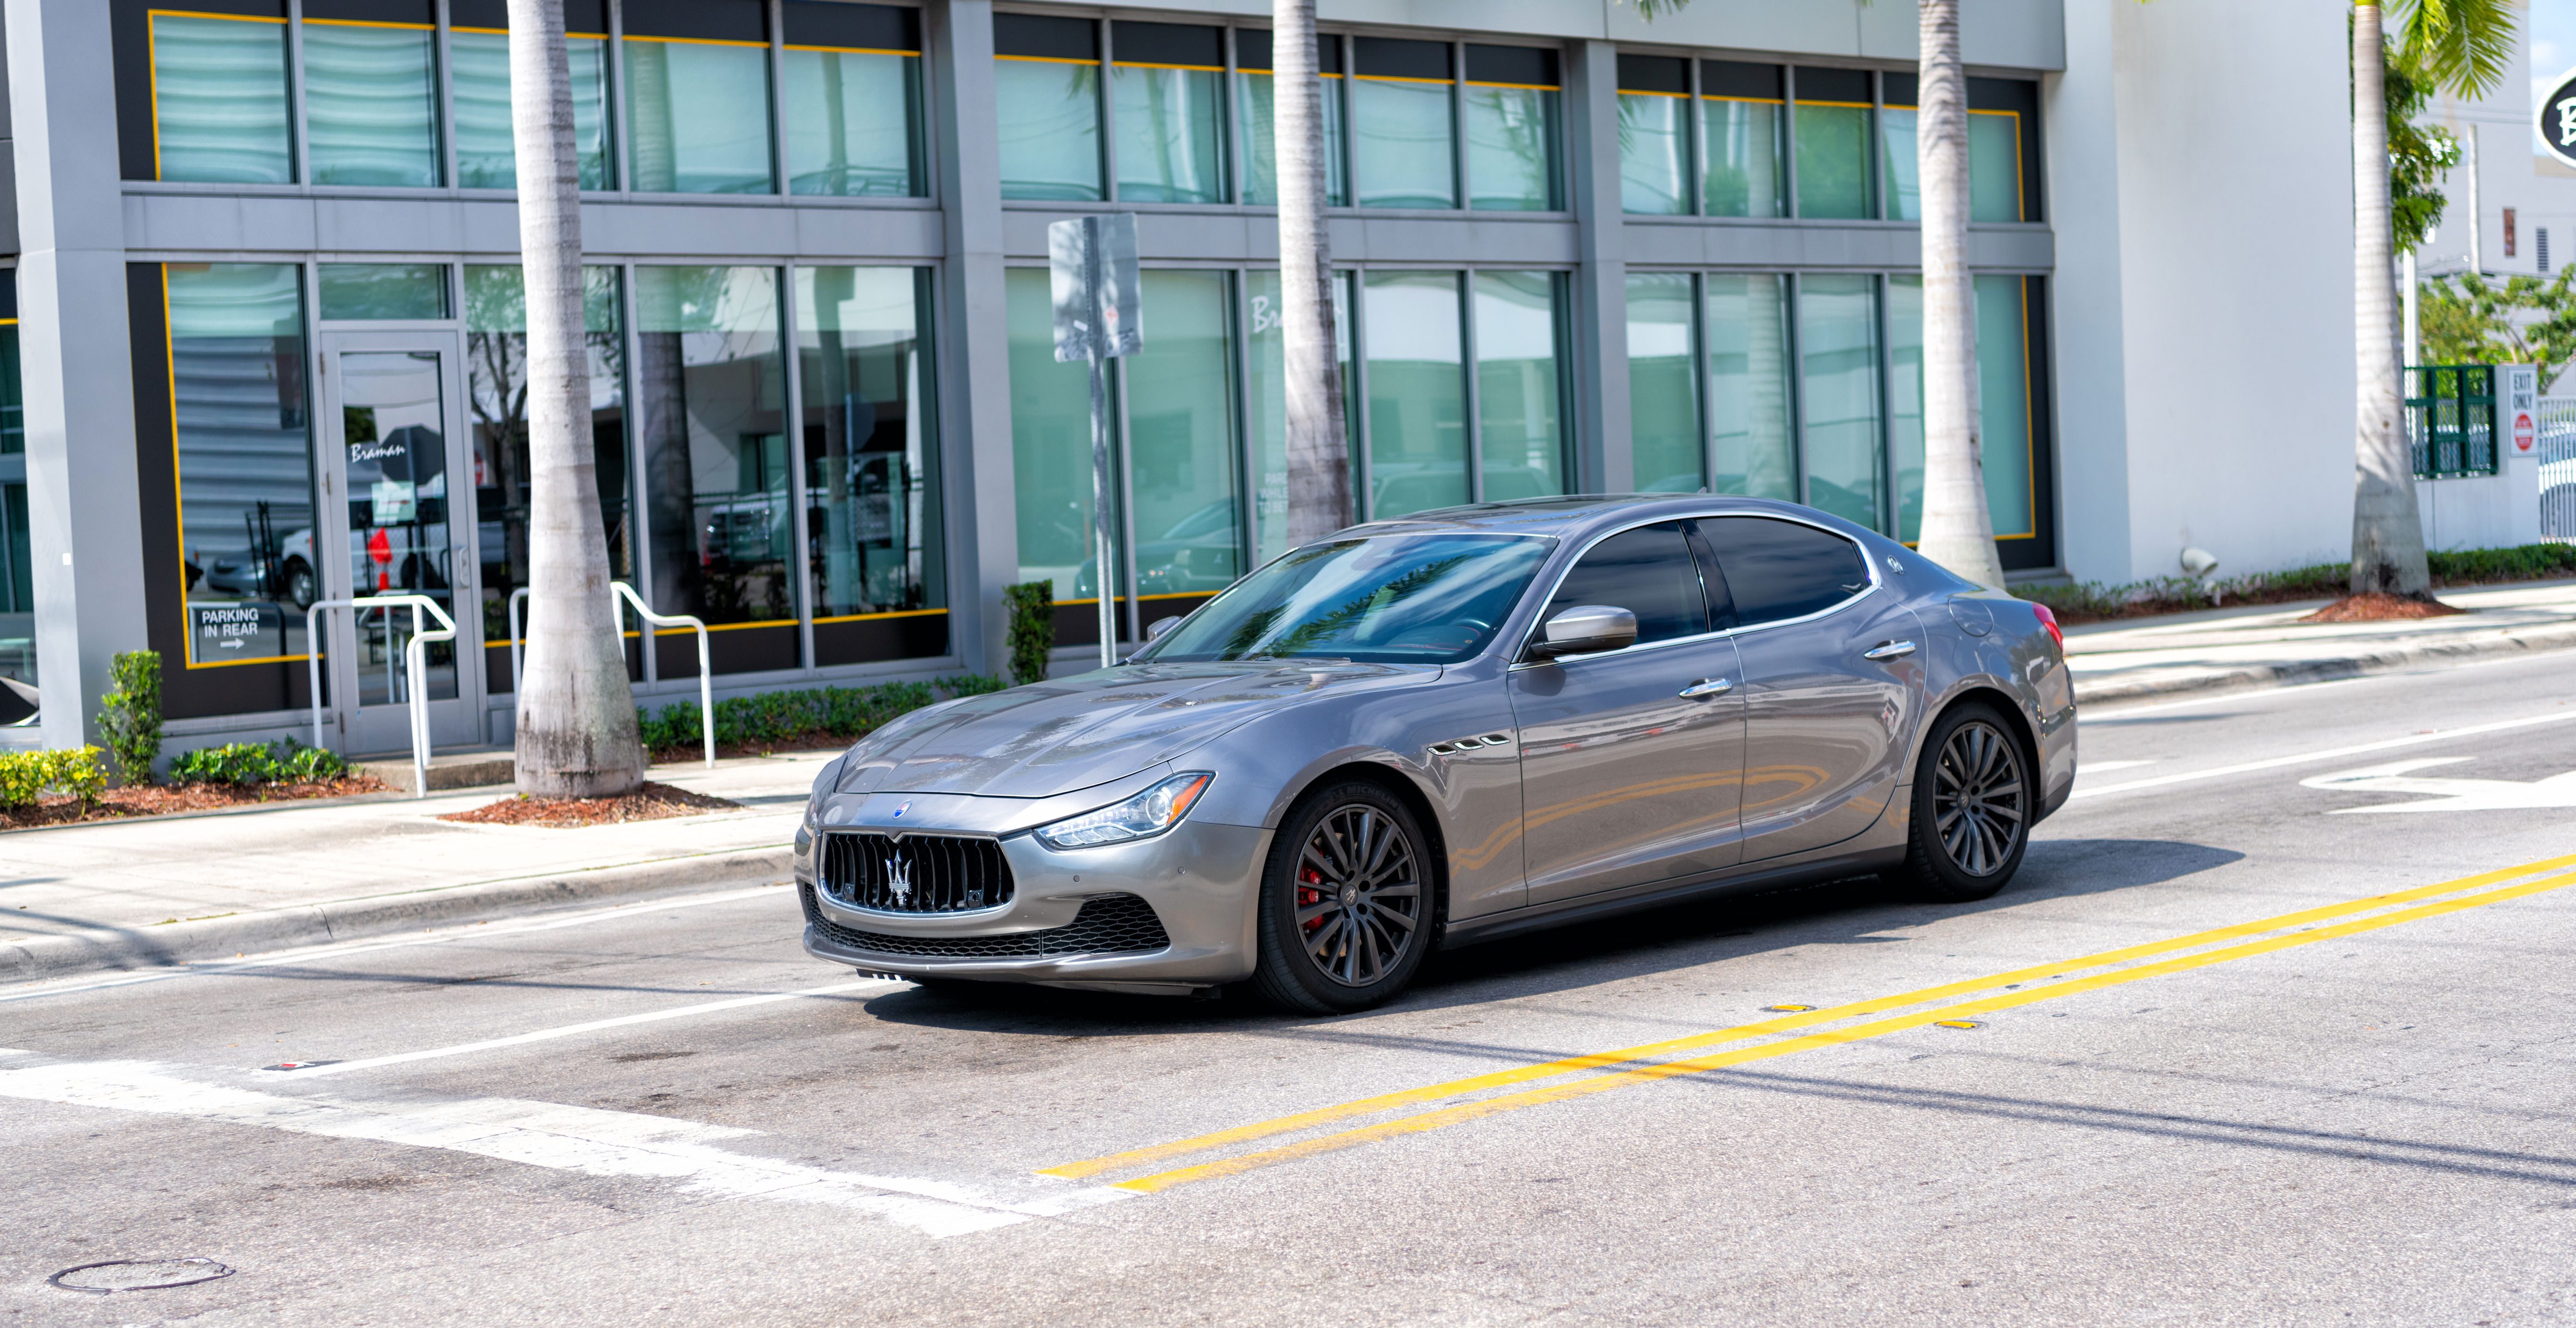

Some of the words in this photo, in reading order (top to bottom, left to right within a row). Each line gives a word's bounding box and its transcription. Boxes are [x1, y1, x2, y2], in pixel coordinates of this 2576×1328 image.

[2514, 373, 2531, 390] EXIT
[2513, 393, 2533, 410] ONLY
[351, 443, 406, 463] Braman
[202, 608, 259, 624] PARKING
[205, 625, 218, 638] IN
[223, 623, 258, 637] REAR
[1346, 785, 1399, 808] MICHELIN
